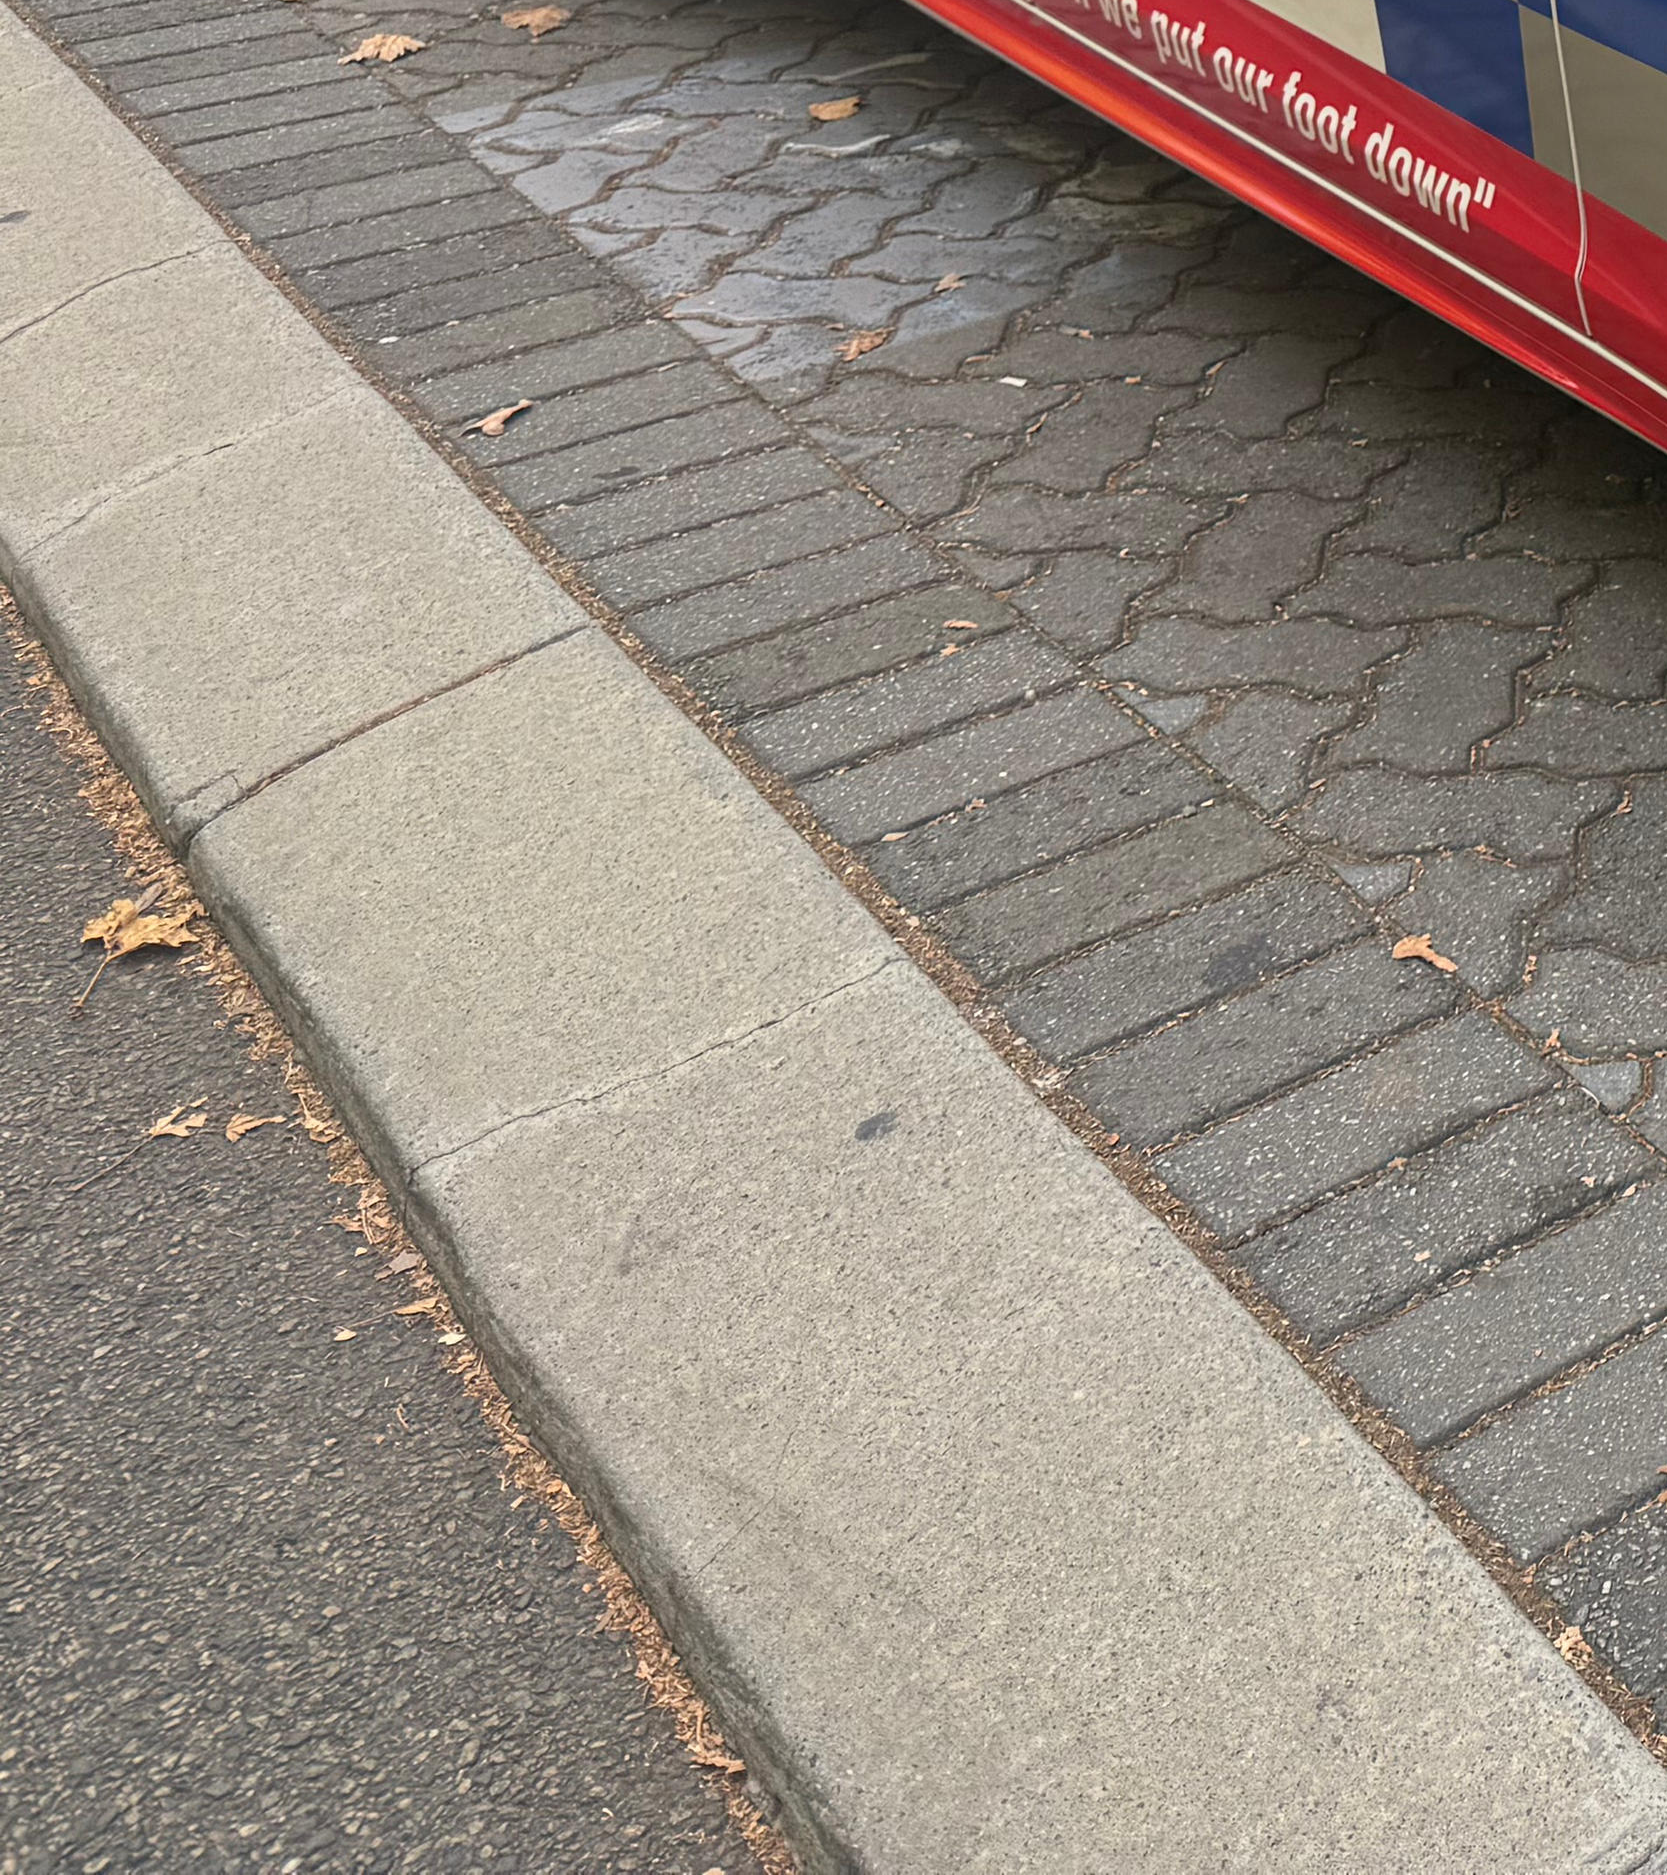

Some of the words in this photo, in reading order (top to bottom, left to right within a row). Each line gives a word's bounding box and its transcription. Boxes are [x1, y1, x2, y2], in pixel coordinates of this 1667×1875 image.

[1150, 9, 1207, 77] put
[1213, 46, 1273, 114] our
[1282, 71, 1358, 165] foot
[1364, 123, 1496, 234] down"
